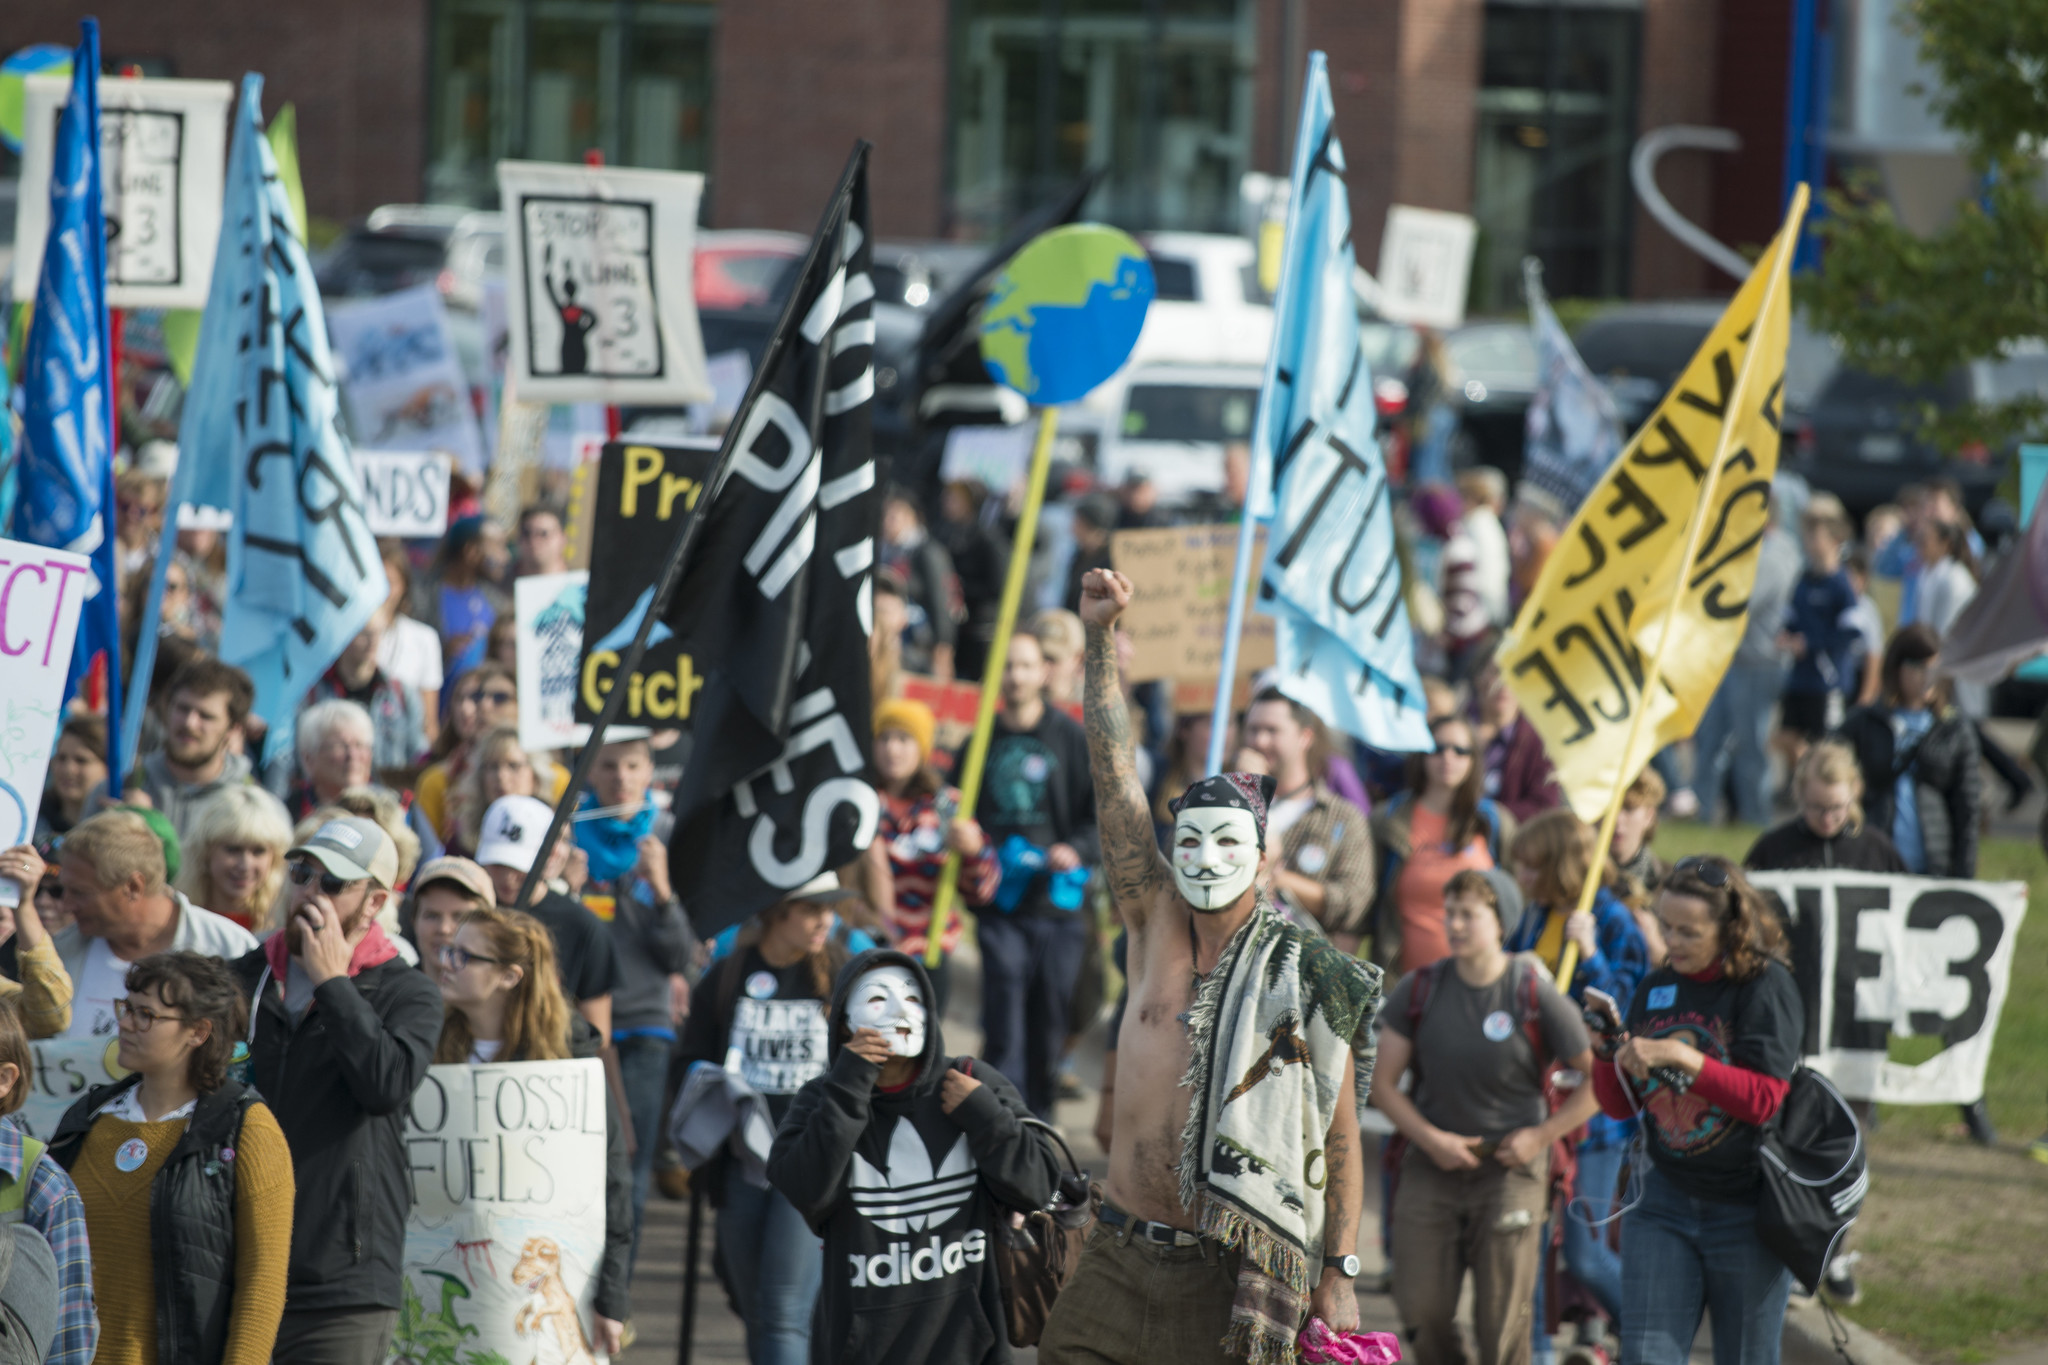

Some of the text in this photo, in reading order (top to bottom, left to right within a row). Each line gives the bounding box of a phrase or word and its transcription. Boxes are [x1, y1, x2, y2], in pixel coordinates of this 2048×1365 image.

[536, 208, 608, 239] STOP
[612, 297, 640, 338] 3
[0, 559, 88, 667] CT
[31, 1044, 86, 1098] ts
[744, 1037, 813, 1059] LIVES
[402, 1067, 605, 1136] O FOSSIL
[405, 1132, 555, 1206] FUELS
[848, 1228, 987, 1288] adidas
